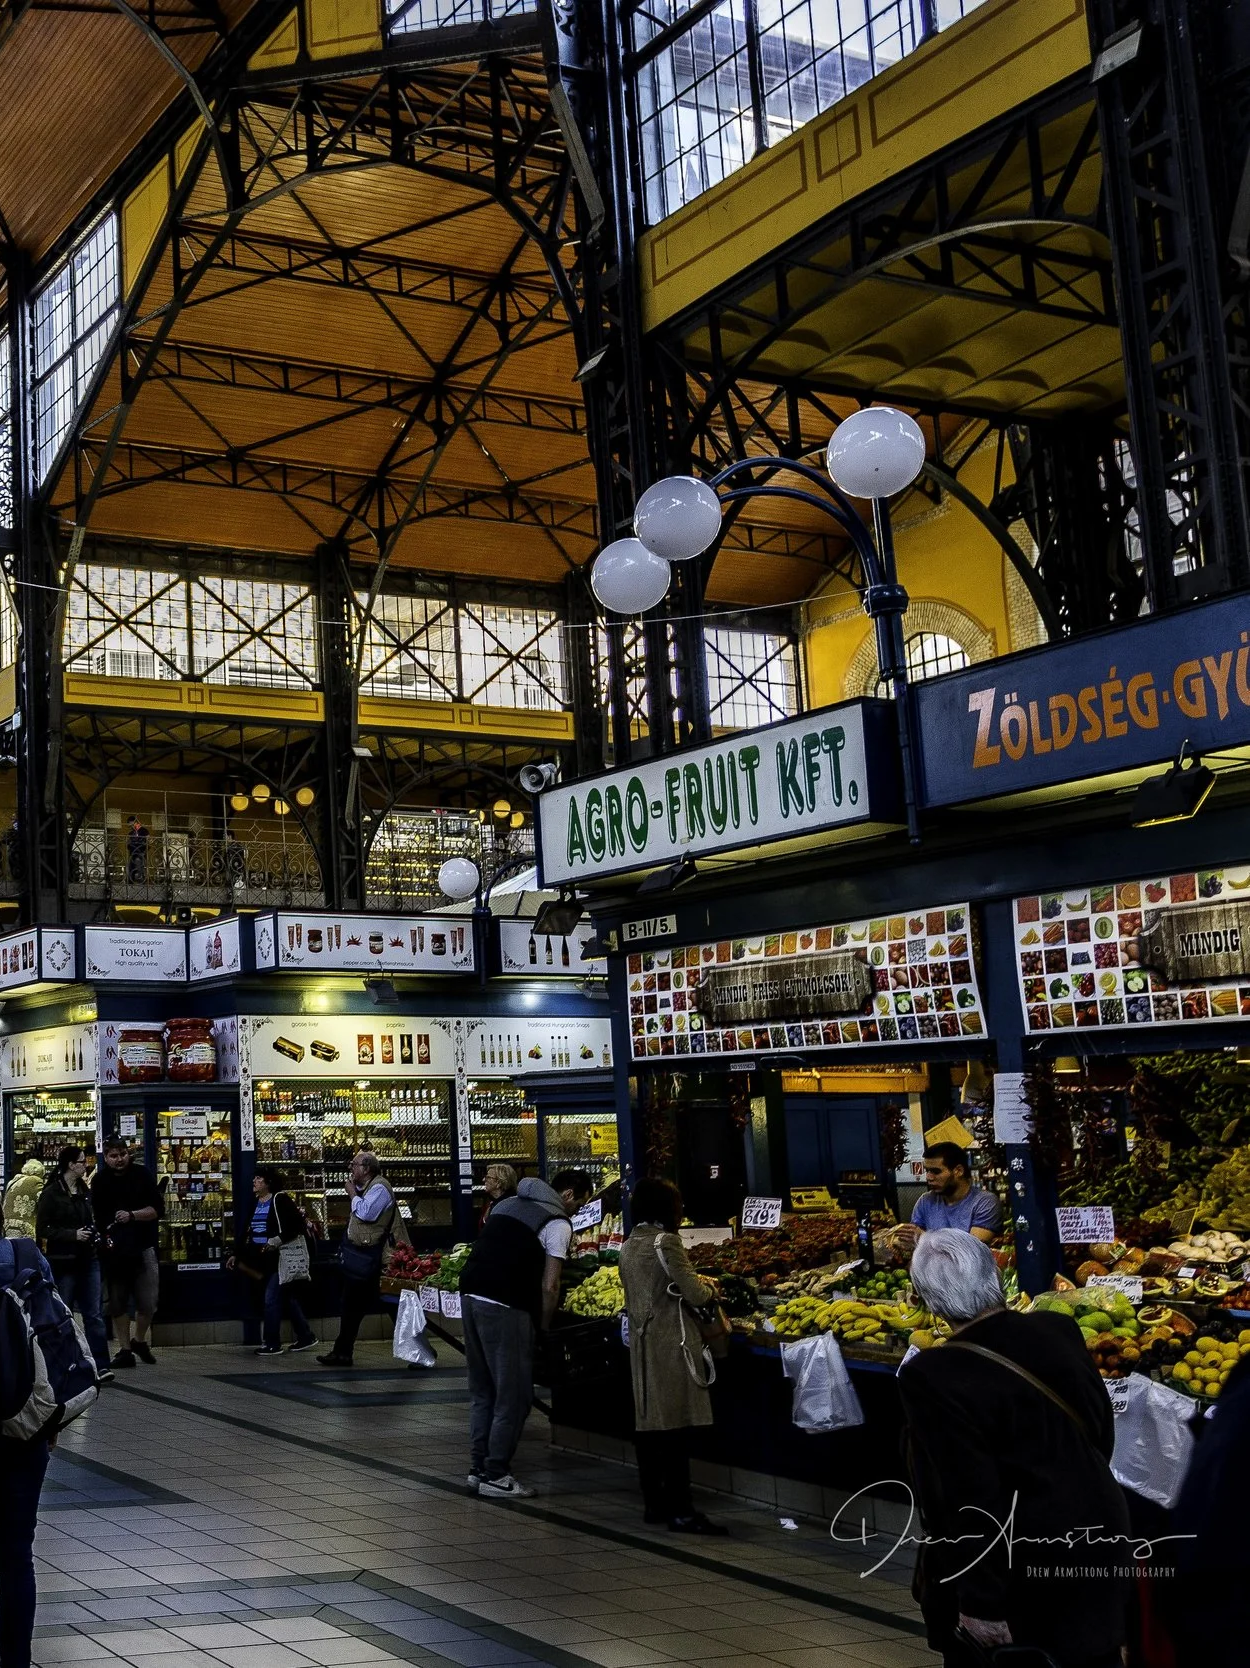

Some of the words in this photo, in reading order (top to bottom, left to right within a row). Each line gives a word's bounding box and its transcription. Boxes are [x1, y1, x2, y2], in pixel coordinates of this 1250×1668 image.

[566, 745, 760, 867] AGRO-FRUIT
[776, 725, 859, 819] KFT.
[118, 948, 154, 960] TOKAJI
[1178, 927, 1241, 958] MINDIG
[714, 985, 748, 1006] MINDIG
[751, 982, 779, 1001] FRISS
[181, 1117, 198, 1126] Tokaji
